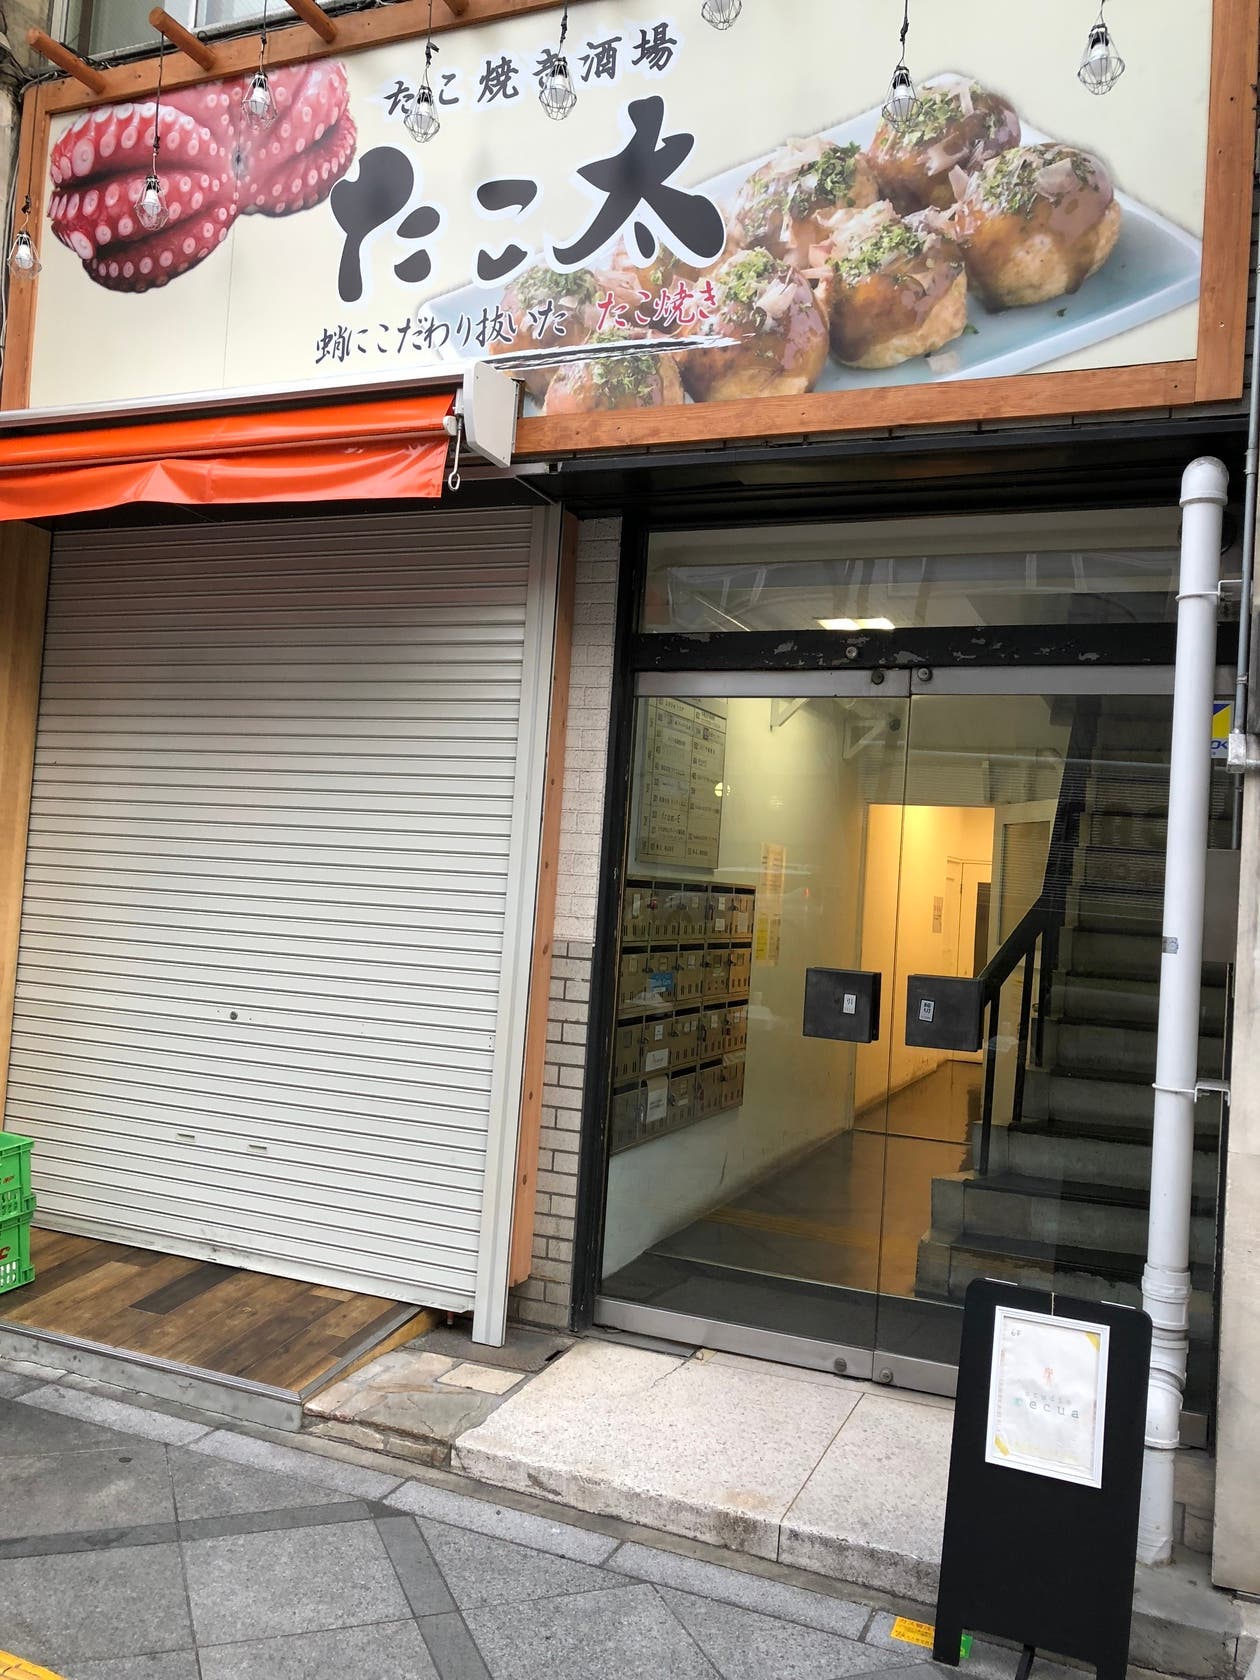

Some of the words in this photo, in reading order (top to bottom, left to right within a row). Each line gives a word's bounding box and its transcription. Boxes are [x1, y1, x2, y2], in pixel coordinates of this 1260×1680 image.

[331, 96, 726, 302] たこ太
[316, 300, 568, 364] 蛸にこだわり抜いた
[597, 281, 716, 331] たこ焼き
